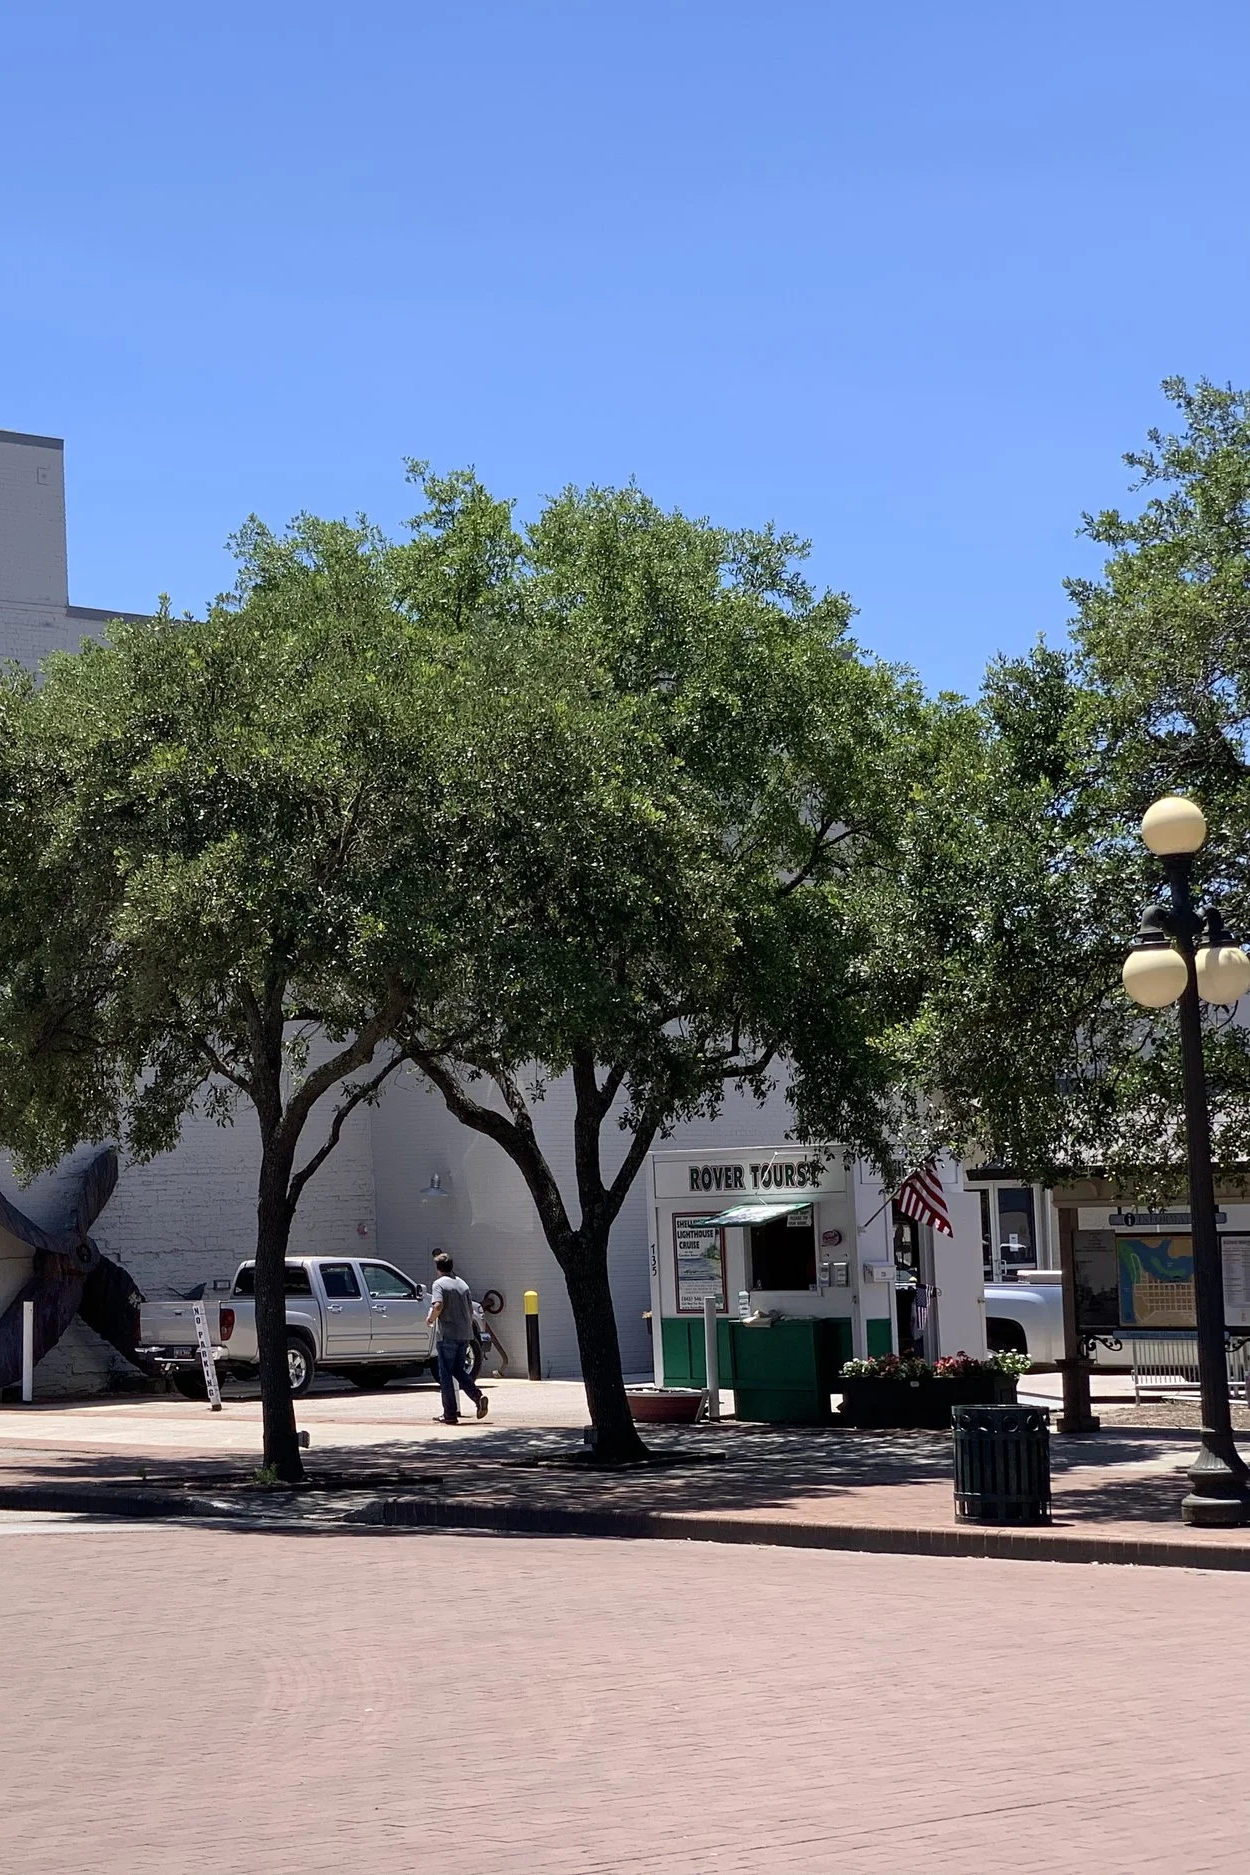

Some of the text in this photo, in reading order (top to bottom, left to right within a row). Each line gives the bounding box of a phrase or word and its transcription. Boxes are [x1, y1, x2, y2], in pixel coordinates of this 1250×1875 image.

[689, 1162, 807, 1193] ROVER TOURS
[677, 1229, 714, 1239] LIGHTHOUSE
[679, 1240, 700, 1250] CRUISE
[194, 1307, 201, 1324] NO
[198, 1331, 215, 1397] PARKING
